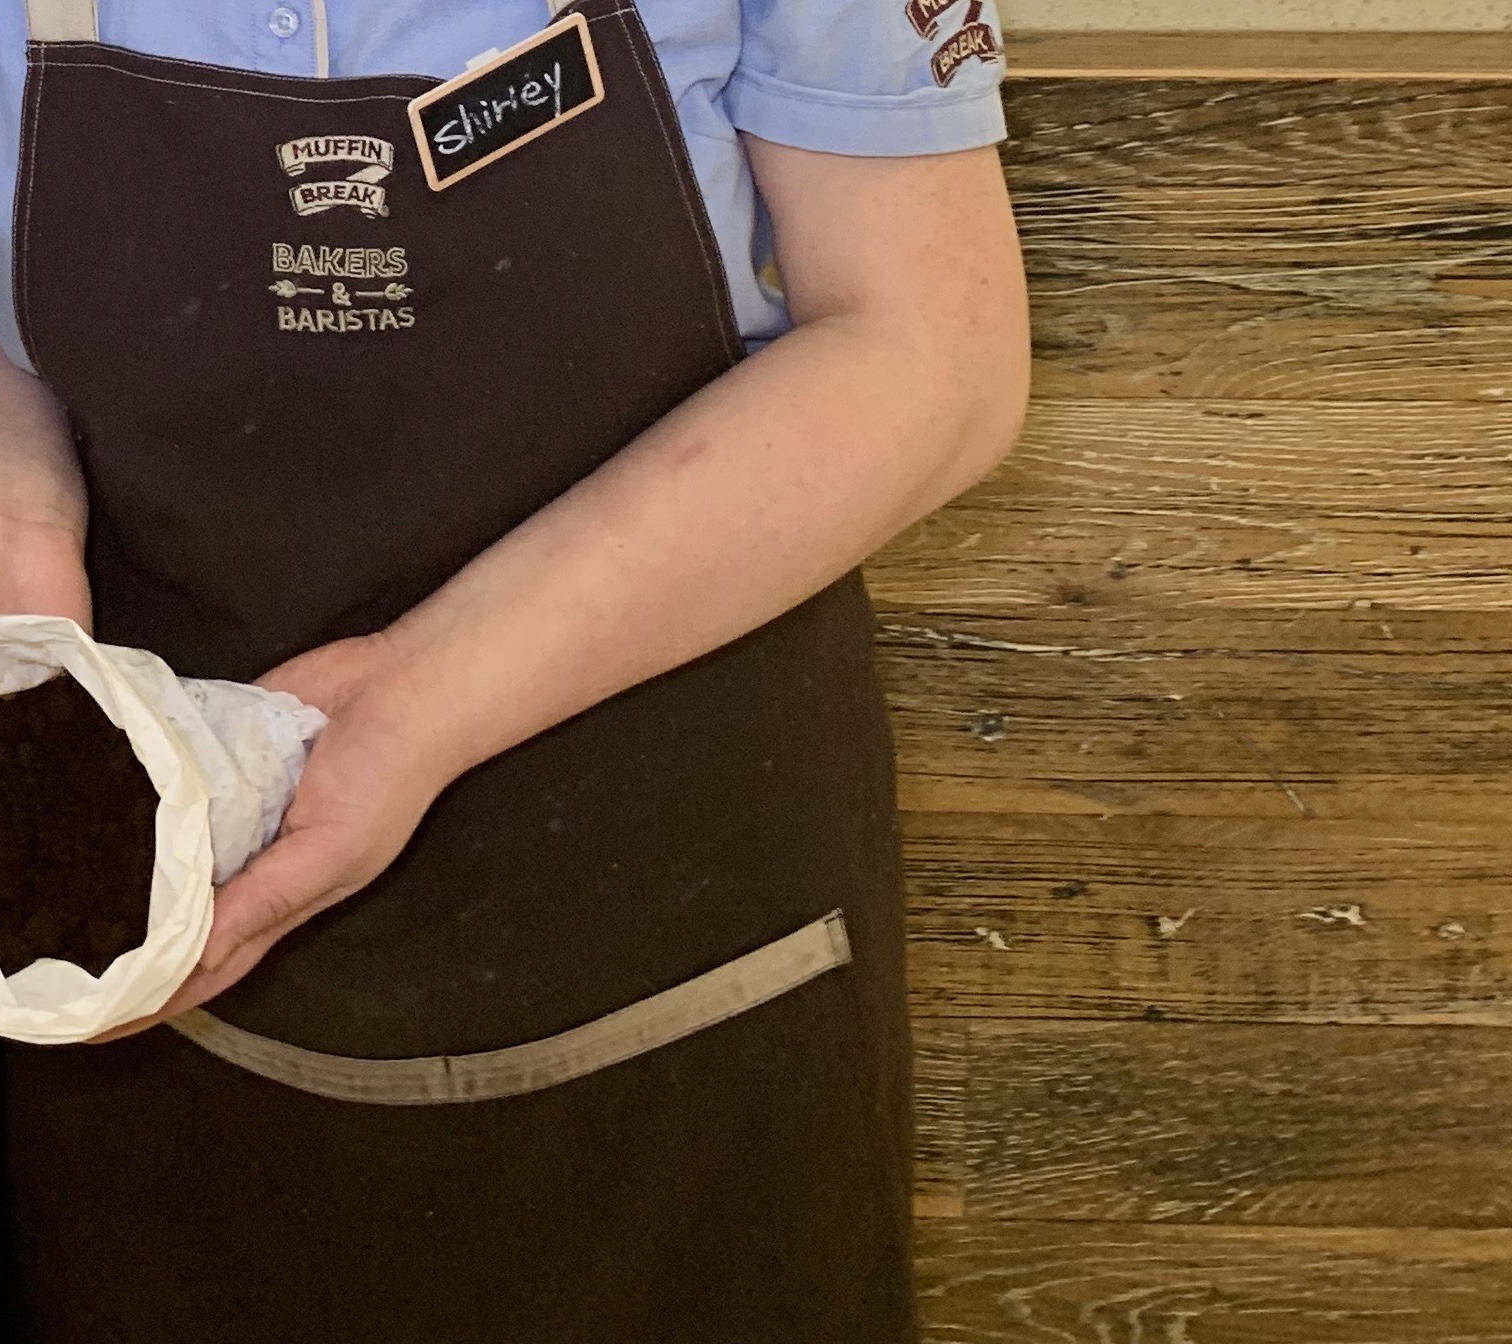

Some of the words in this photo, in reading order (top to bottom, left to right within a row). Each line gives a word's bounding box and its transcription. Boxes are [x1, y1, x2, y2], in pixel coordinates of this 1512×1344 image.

[938, 29, 989, 75] BREAK
[433, 61, 562, 155] Shirley
[291, 138, 383, 160] MUFFIN
[299, 184, 377, 205] BREAK
[272, 242, 409, 279] BAKERS
[331, 282, 353, 307] &
[277, 306, 416, 333] BARISTAS
